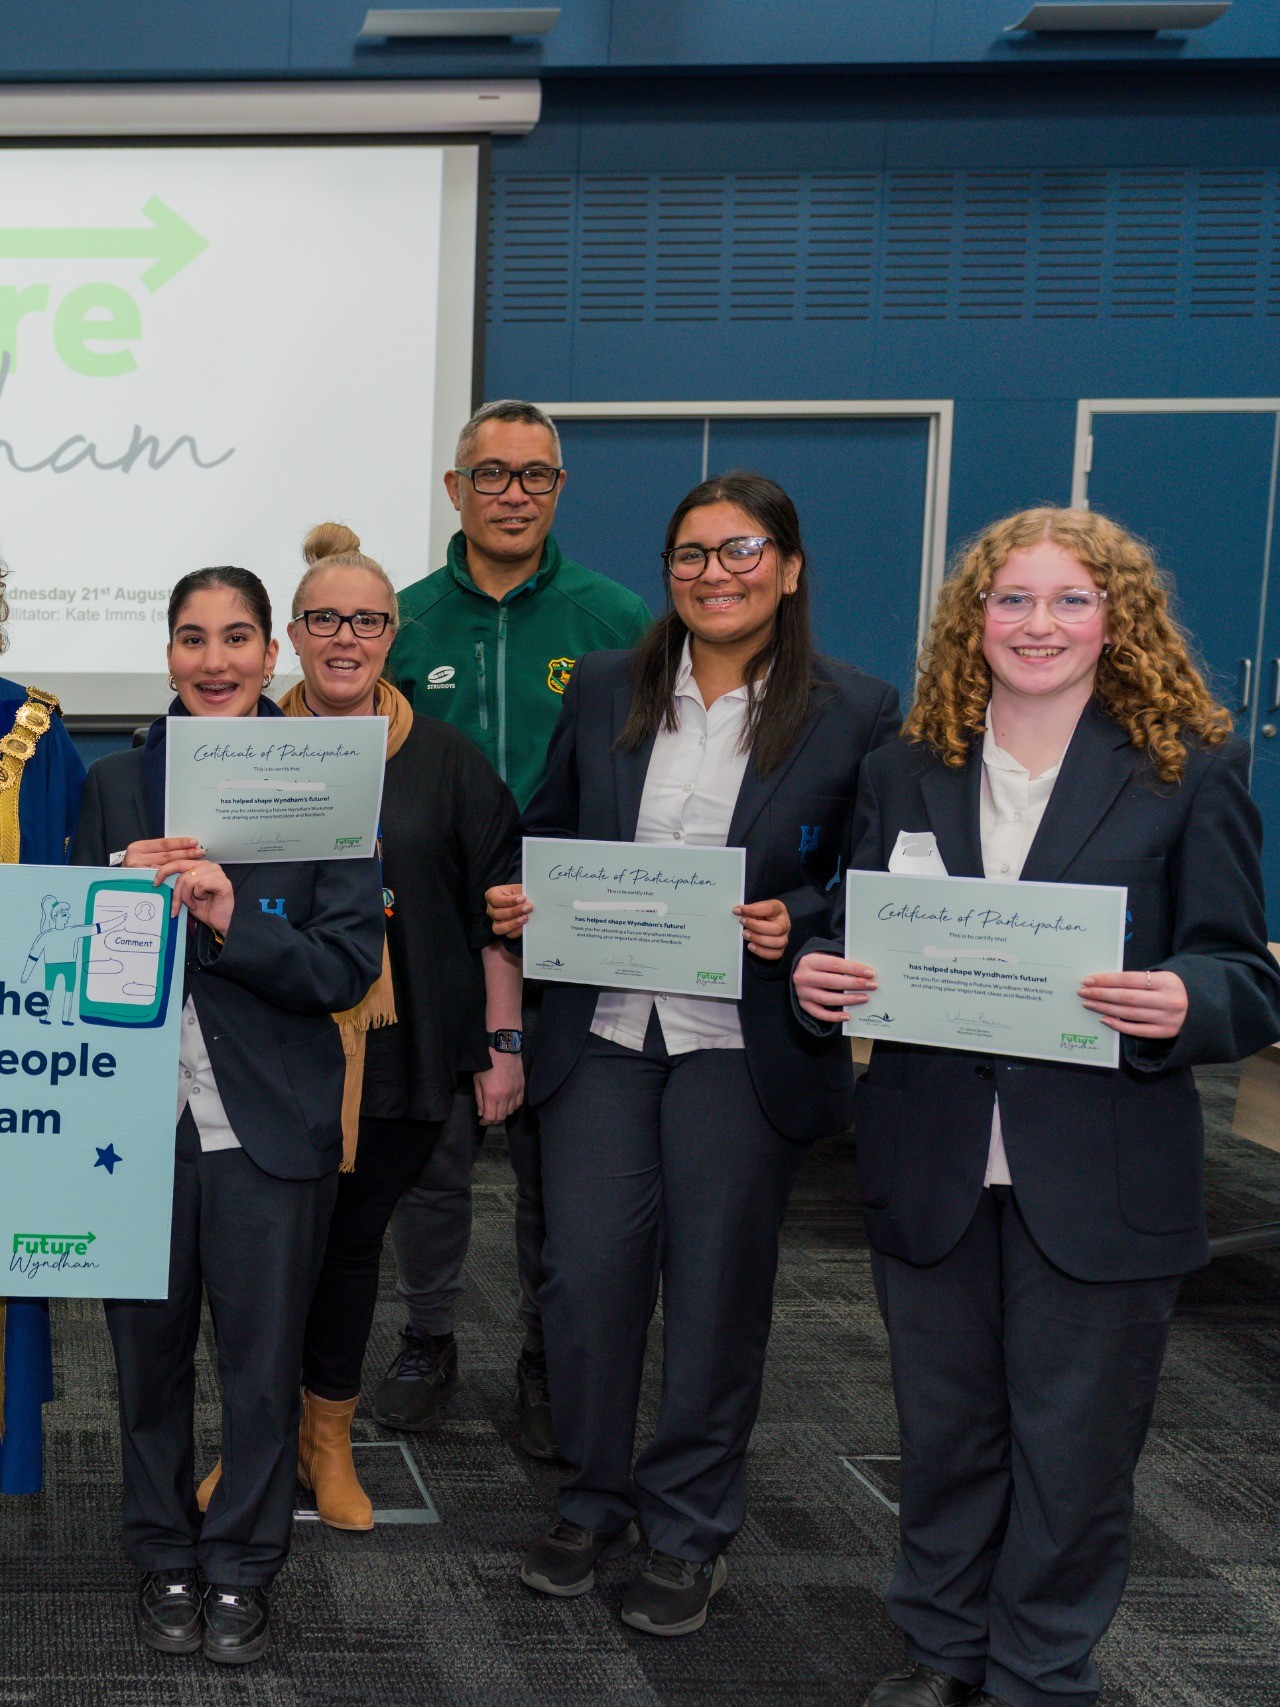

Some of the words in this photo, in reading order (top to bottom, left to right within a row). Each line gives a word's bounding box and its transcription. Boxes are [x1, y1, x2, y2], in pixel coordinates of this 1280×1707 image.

[8, 587, 76, 603] dnesday
[66, 608, 100, 621] Kate
[106, 608, 146, 621] Imms
[194, 744, 257, 763] Certificate
[261, 744, 276, 761] of
[277, 743, 359, 763] Participation
[273, 796, 308, 804] Wyndham's
[548, 864, 610, 881] Certificate
[613, 868, 628, 884] of
[629, 868, 716, 890] Participation
[627, 920, 663, 928] Wyndham's
[877, 902, 953, 923] Certificate
[957, 909, 975, 927] of
[977, 909, 1087, 936] Participation
[115, 937, 152, 947] Comment
[698, 971, 724, 980] Future
[908, 963, 922, 971] has
[923, 965, 949, 974] helped
[949, 968, 973, 977] shape
[973, 970, 1019, 980] Wyndham's
[1019, 974, 1047, 983] future!
[903, 974, 920, 982] Thank
[993, 983, 1023, 992] Wyndham
[956, 987, 986, 996] important
[1062, 1033, 1096, 1045] Future
[13, 1232, 90, 1255] Future
[10, 1250, 99, 1279] Wyndham
